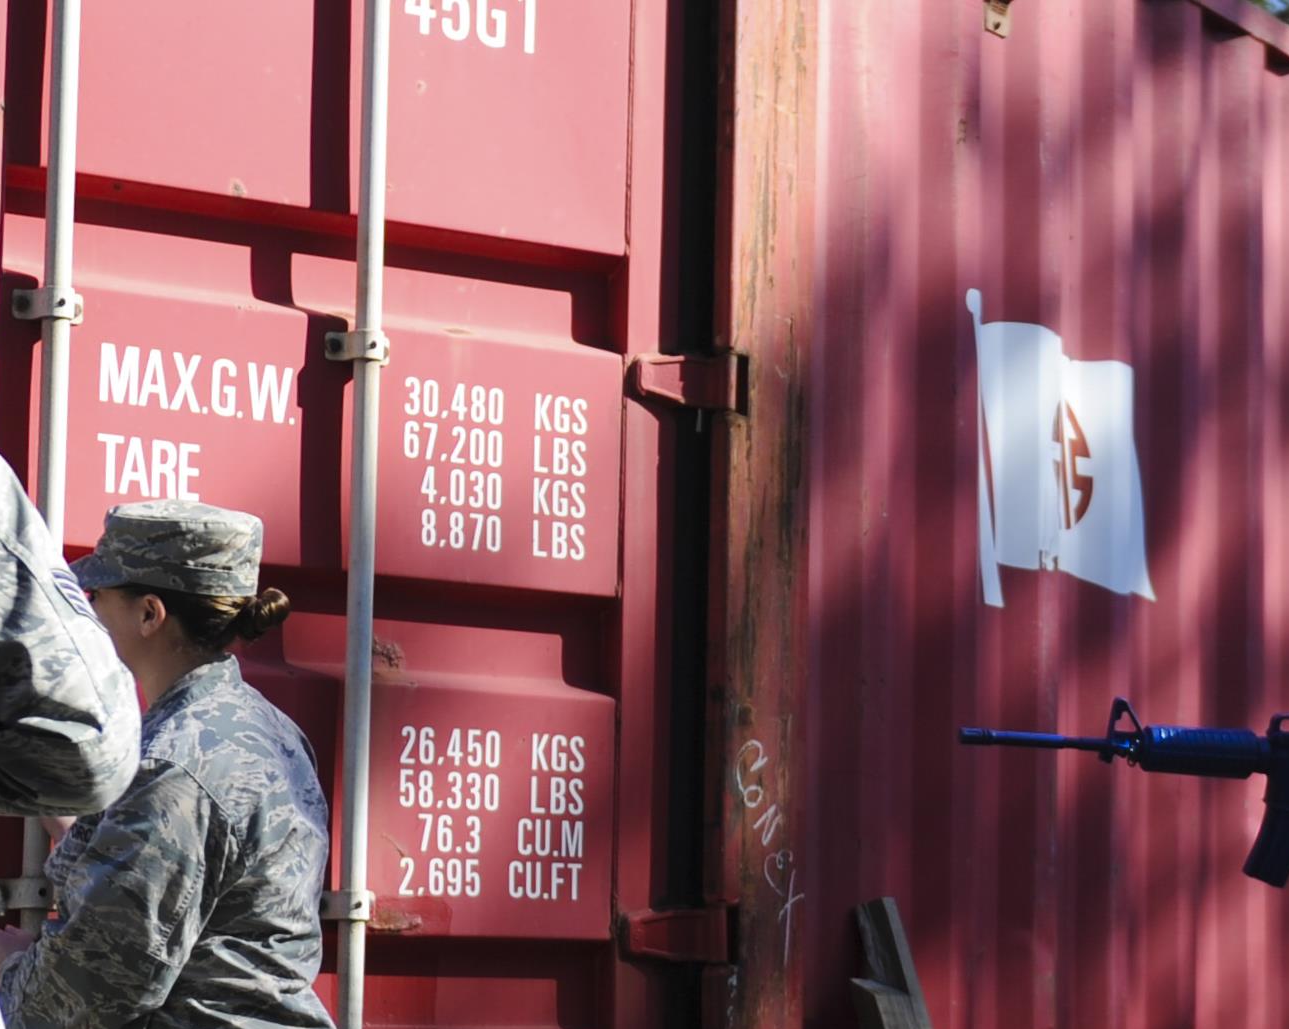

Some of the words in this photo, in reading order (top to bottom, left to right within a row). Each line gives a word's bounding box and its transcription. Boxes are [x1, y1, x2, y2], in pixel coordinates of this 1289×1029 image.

[98, 341, 296, 426] MAX.G.W.
[403, 375, 505, 426] 30,480
[533, 392, 589, 436] KGS
[96, 431, 202, 502] TARE
[402, 419, 504, 469] 67,200
[532, 434, 588, 478] LBS
[420, 464, 503, 511] 4,030
[532, 476, 587, 520] KGS
[420, 507, 502, 553] 8,870
[532, 518, 586, 562] LBS
[399, 725, 502, 769] 26,450
[530, 732, 586, 773] KGS
[398, 768, 501, 812] 58,330
[529, 774, 585, 817] LBS
[417, 812, 482, 855] 76.3
[516, 817, 584, 859] CU.M
[397, 856, 481, 898] 2,695
[507, 859, 583, 902] CU.FT
